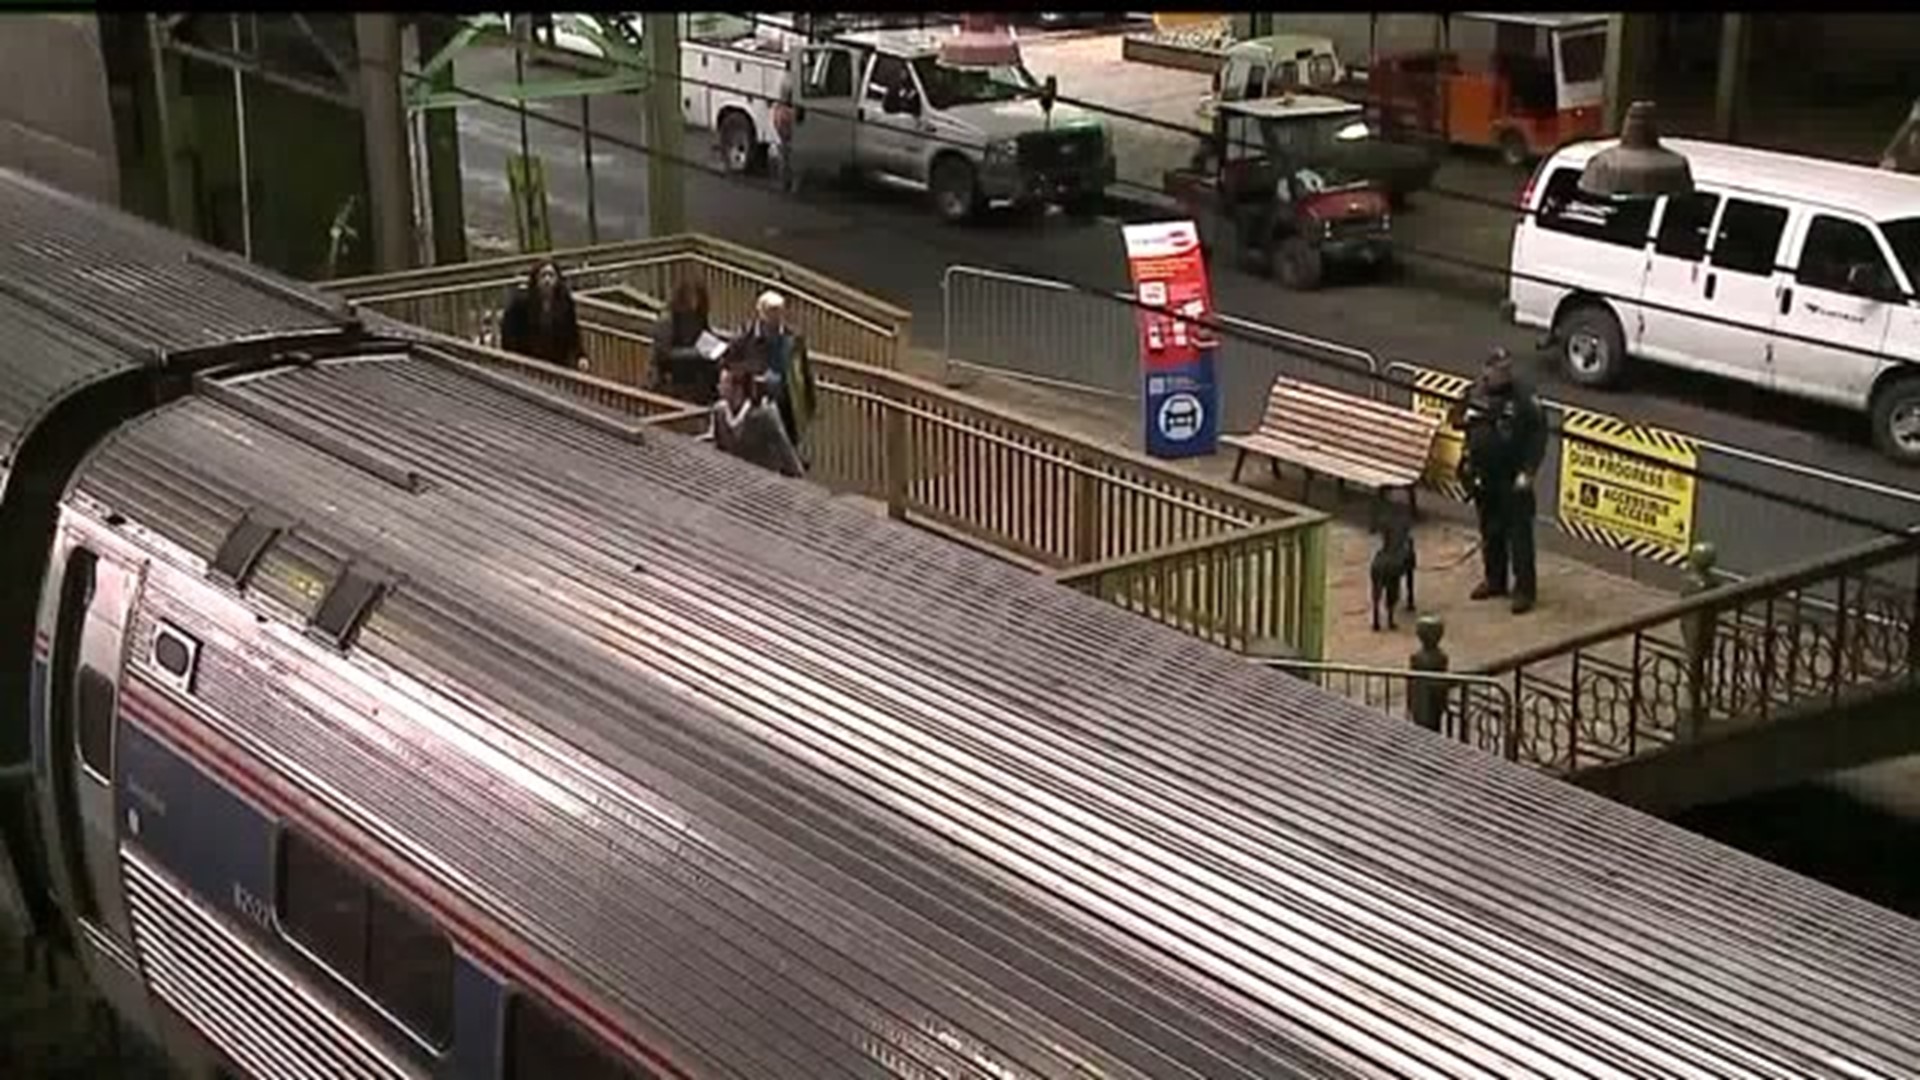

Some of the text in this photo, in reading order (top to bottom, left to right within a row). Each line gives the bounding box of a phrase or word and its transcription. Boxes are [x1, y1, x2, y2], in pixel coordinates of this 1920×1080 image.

[1569, 449, 1596, 468] OUR
[1599, 458, 1664, 488] PROGRESS
[1603, 489, 1669, 517] ACCESSIBLE
[1614, 504, 1657, 526] ACCESS
